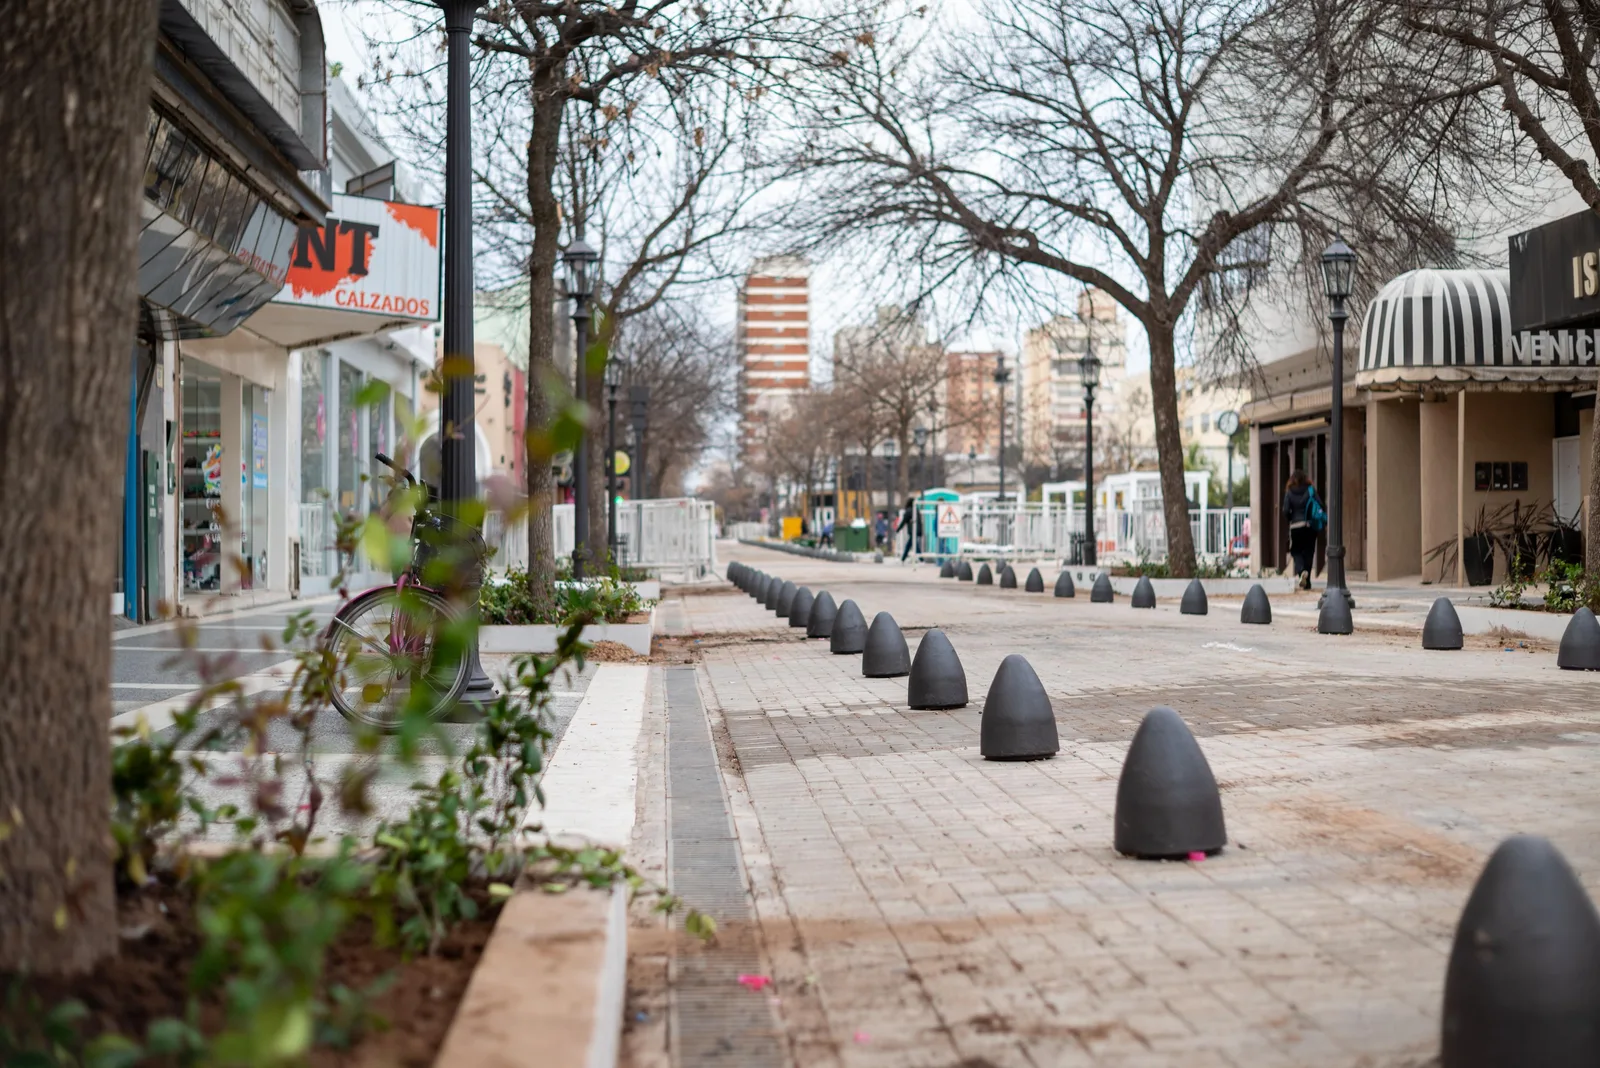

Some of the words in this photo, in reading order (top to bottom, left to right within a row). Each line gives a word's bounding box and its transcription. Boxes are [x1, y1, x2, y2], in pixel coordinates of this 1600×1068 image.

[293, 217, 380, 276] NT
[1572, 251, 1600, 299] IS
[335, 289, 429, 316] CALZADOS
